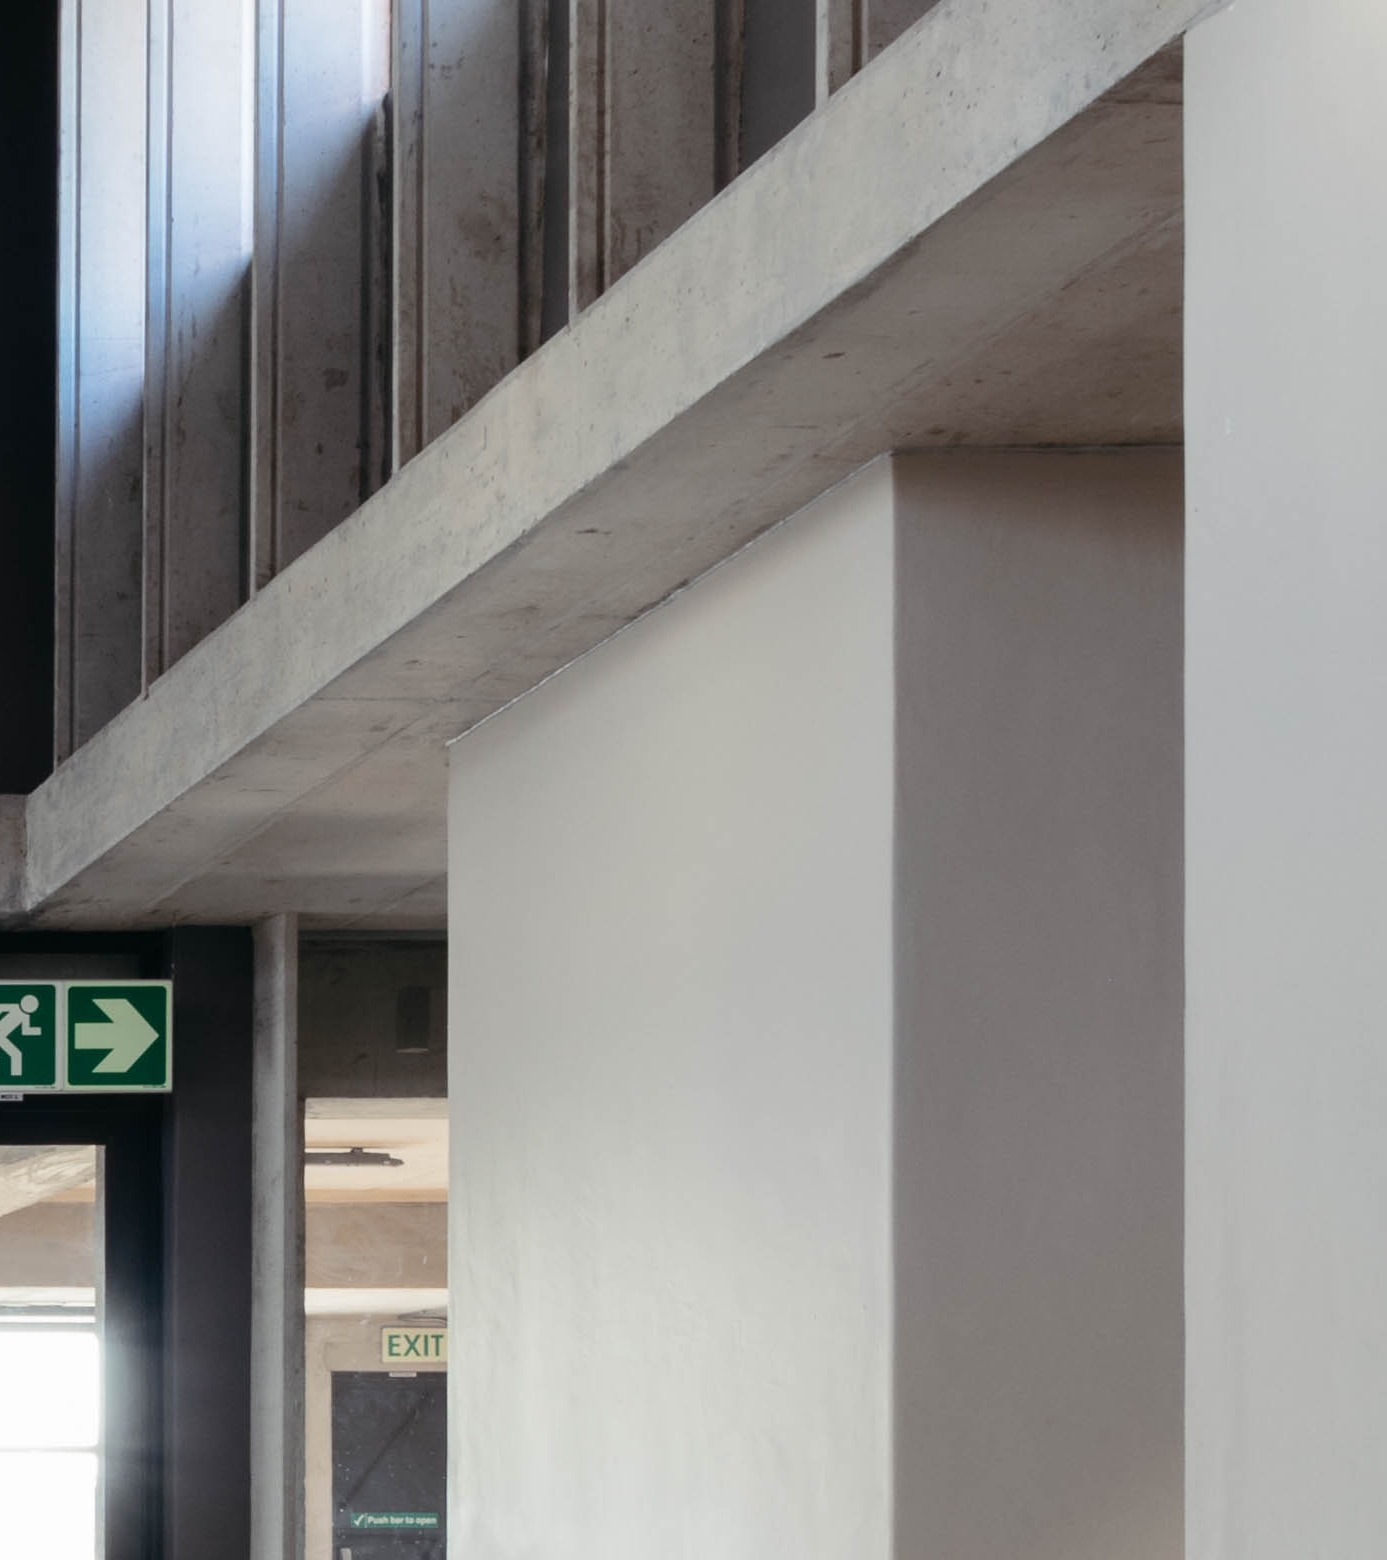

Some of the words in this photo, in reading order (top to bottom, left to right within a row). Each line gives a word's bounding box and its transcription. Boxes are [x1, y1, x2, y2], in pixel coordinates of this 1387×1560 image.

[388, 1334, 444, 1356] EXIT
[367, 1516, 389, 1524] Push
[390, 1516, 404, 1524] bar
[405, 1516, 415, 1524] to
[415, 1517, 437, 1526] open
